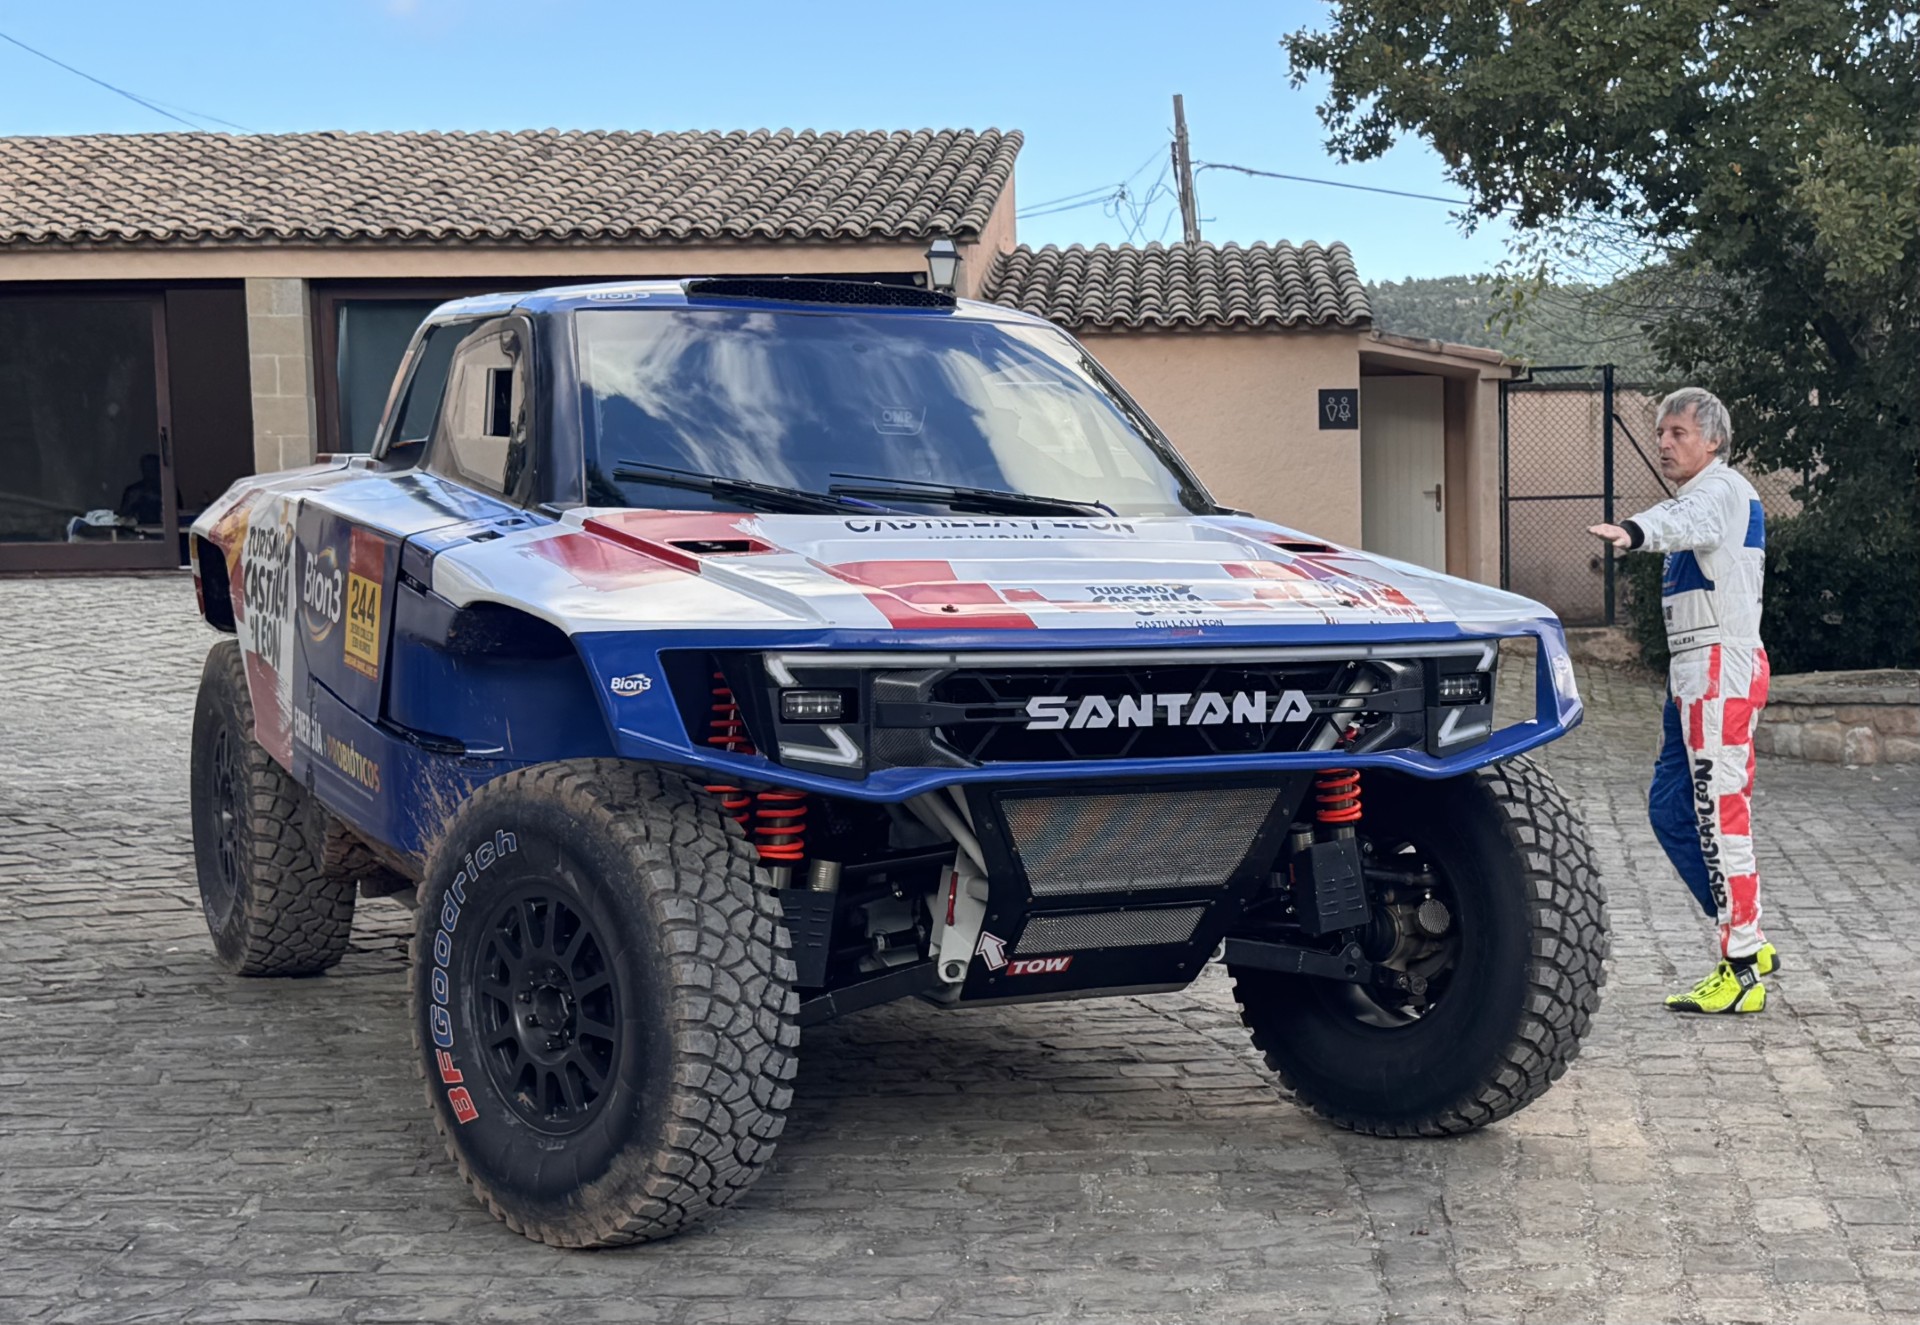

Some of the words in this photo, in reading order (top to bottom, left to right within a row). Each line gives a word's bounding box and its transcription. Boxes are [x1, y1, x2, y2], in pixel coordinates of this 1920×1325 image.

[882, 410, 912, 423] OMP
[244, 558, 290, 624] CASTILLA
[303, 551, 343, 624] Bion3
[351, 578, 376, 629] 244
[610, 677, 652, 691] Bion3
[1025, 690, 1314, 730] SANTANA
[430, 829, 518, 1125] BFGoodrich
[1013, 957, 1070, 975] TOW
